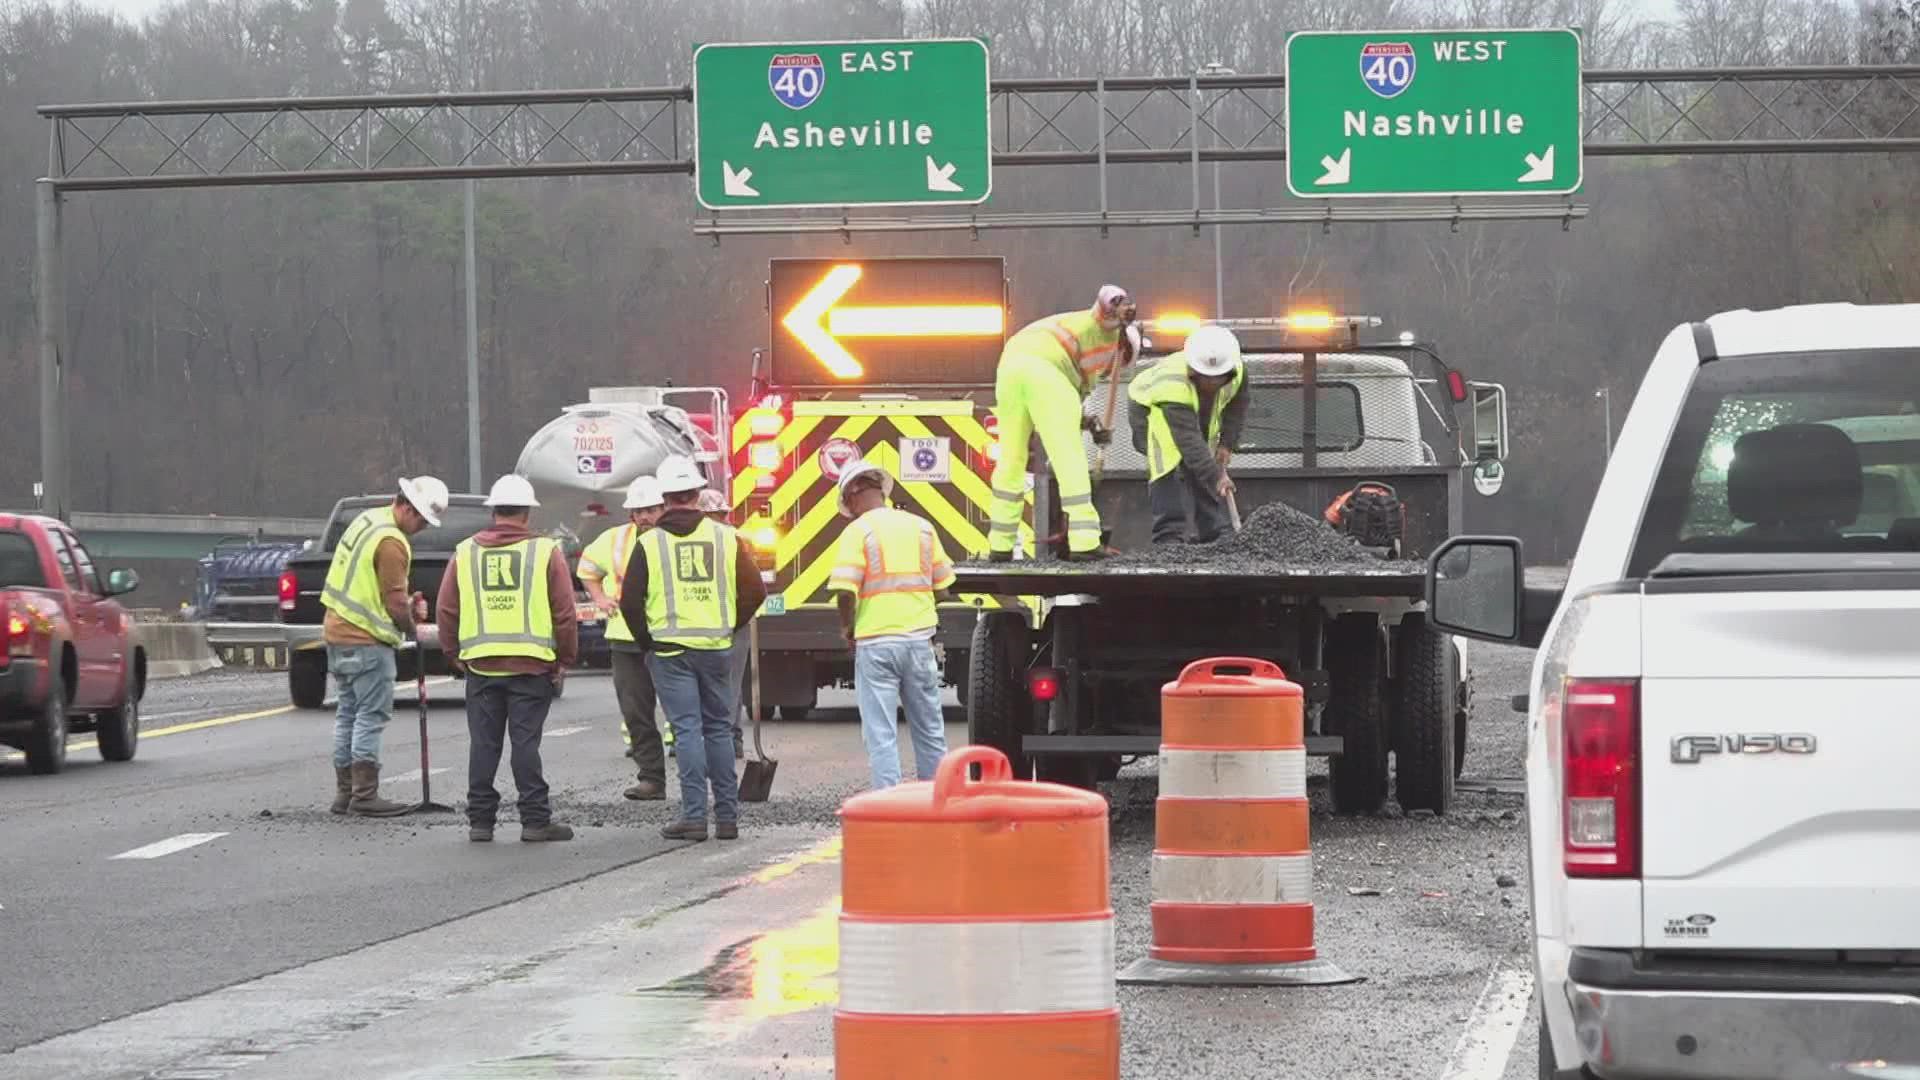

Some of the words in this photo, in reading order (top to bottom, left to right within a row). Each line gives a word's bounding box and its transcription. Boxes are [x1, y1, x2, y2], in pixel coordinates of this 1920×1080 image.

[841, 51, 913, 72] EAST
[1434, 41, 1507, 61] WEST
[775, 68, 818, 98] 40
[1366, 56, 1409, 86] 40
[753, 120, 933, 149] Asheville
[1344, 108, 1524, 137] Nashville
